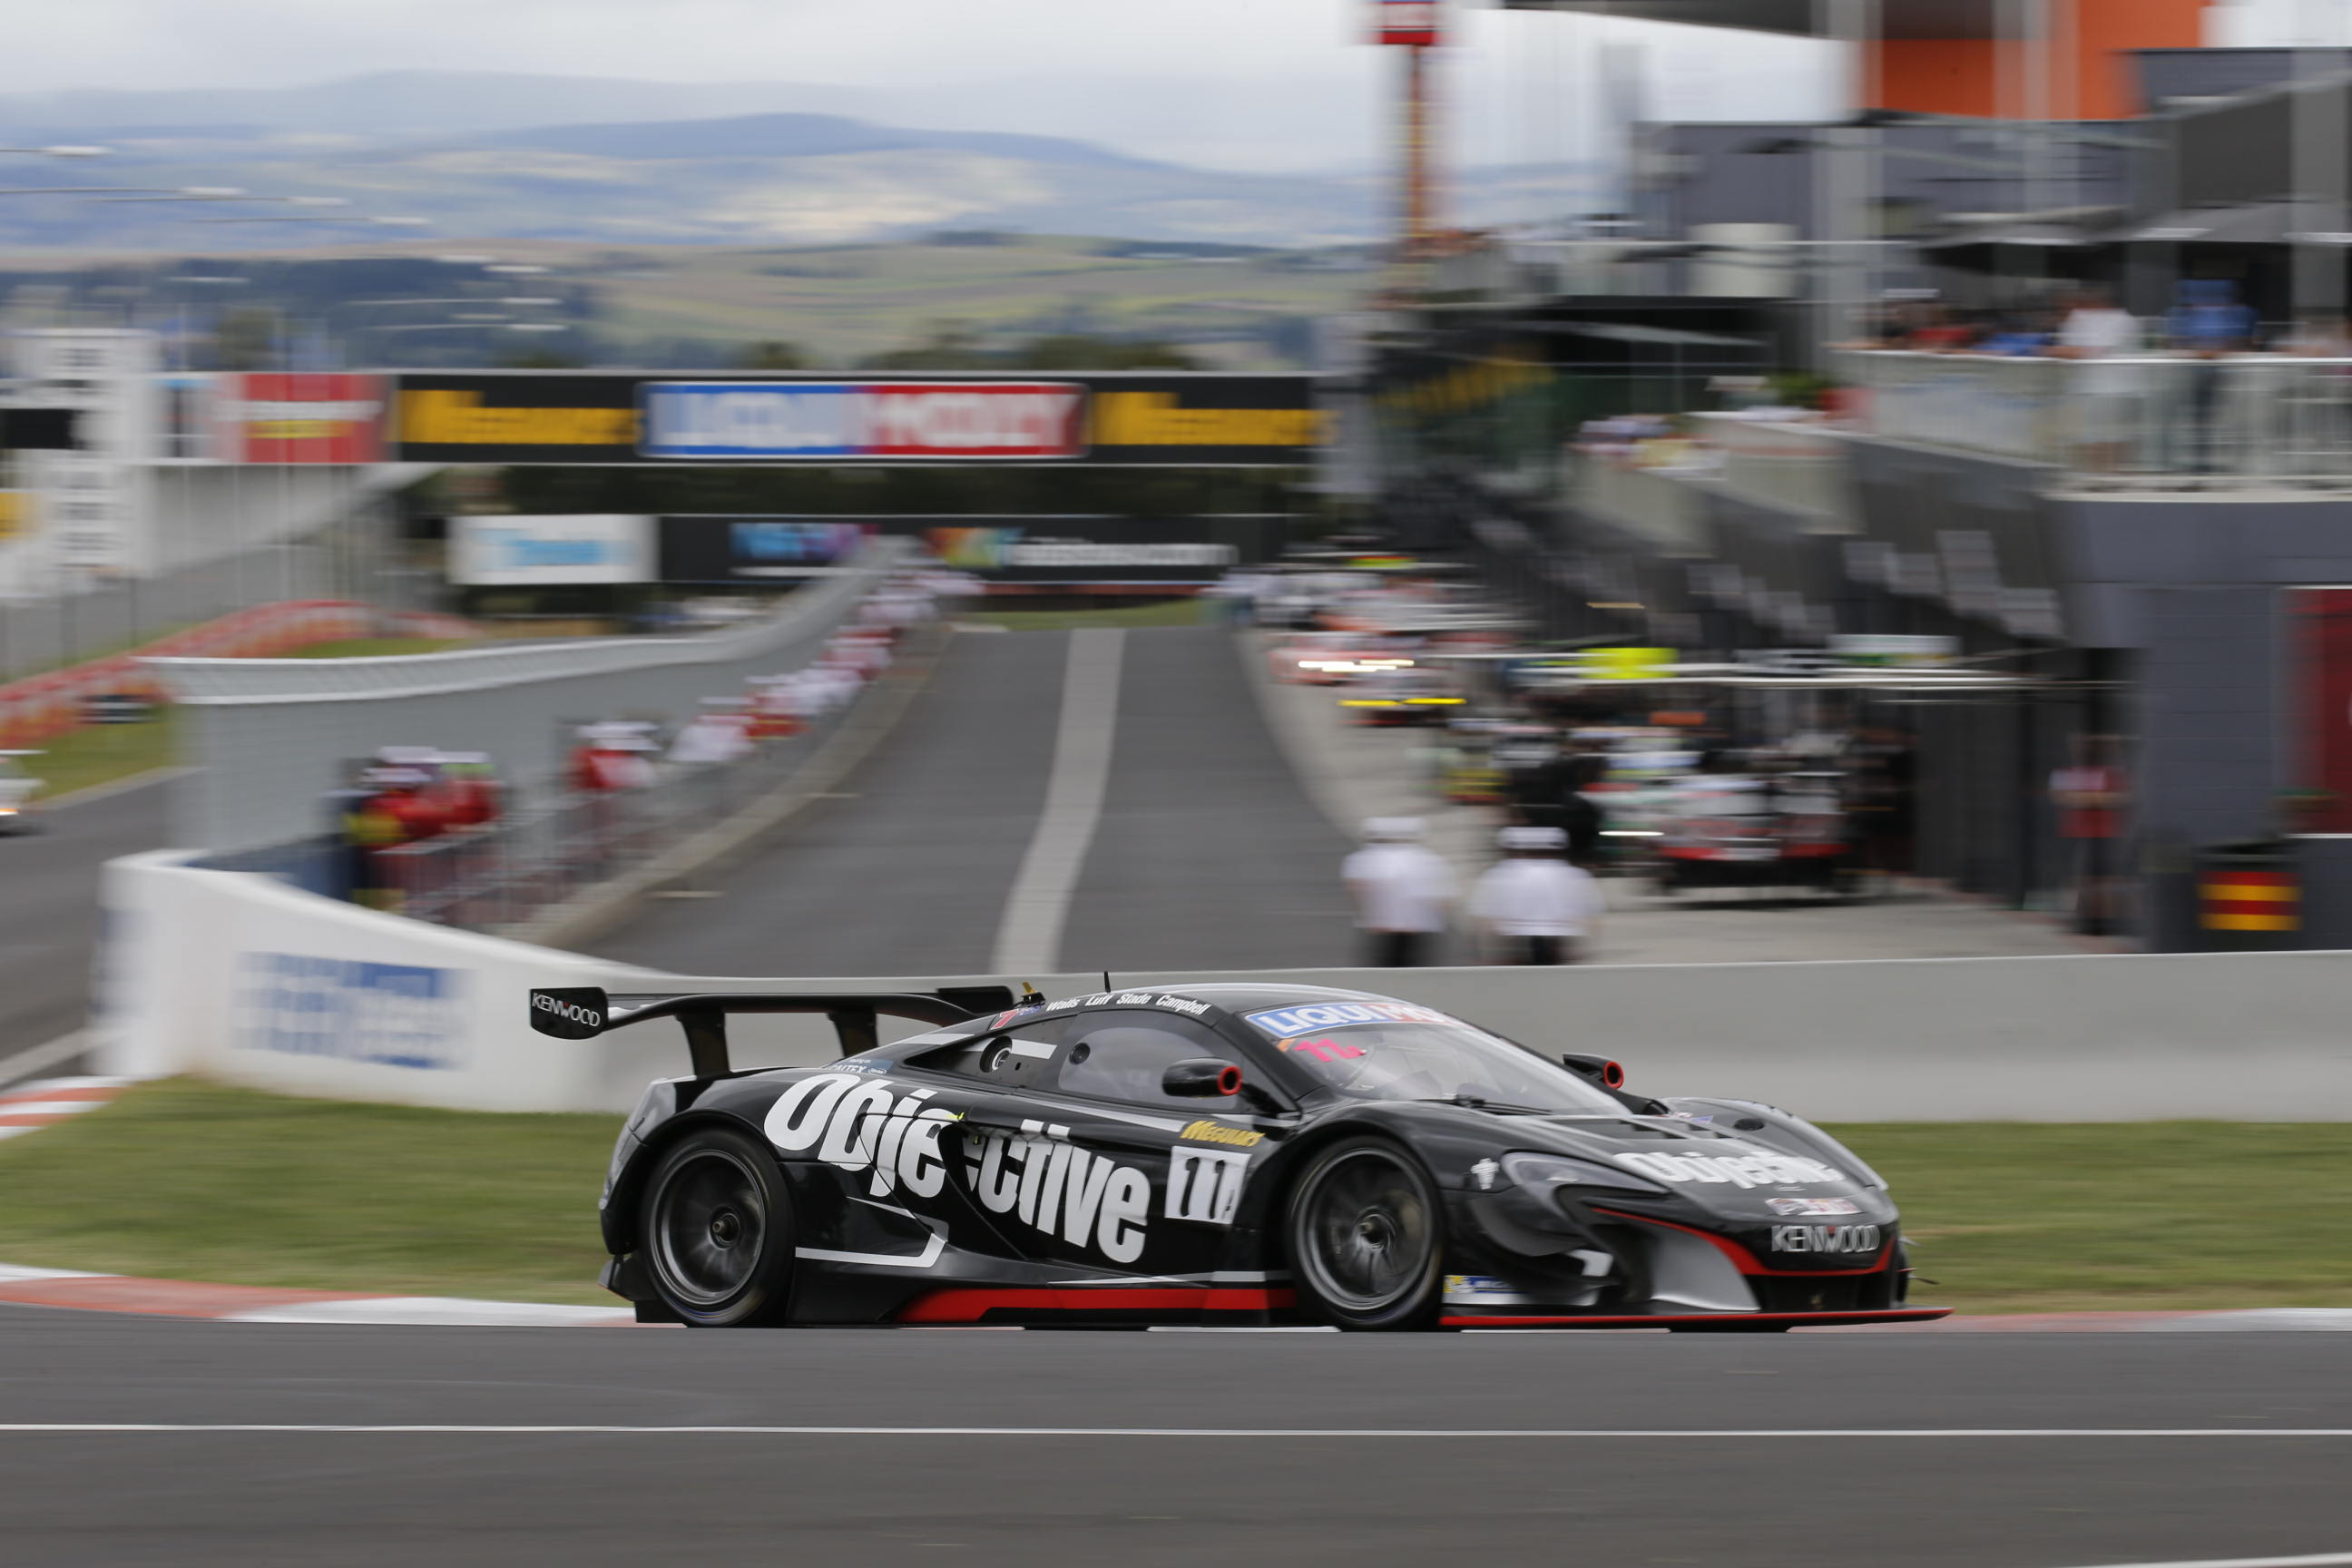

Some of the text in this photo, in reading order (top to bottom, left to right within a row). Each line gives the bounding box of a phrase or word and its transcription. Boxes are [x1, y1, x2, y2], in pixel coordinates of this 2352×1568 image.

[532, 993, 601, 1027] KENWOOD
[1155, 994, 1212, 1015] Campbell
[1258, 1004, 1387, 1034] LIQUI
[764, 1073, 1151, 1263] Objective
[1771, 1225, 1881, 1253] KENWOOD
